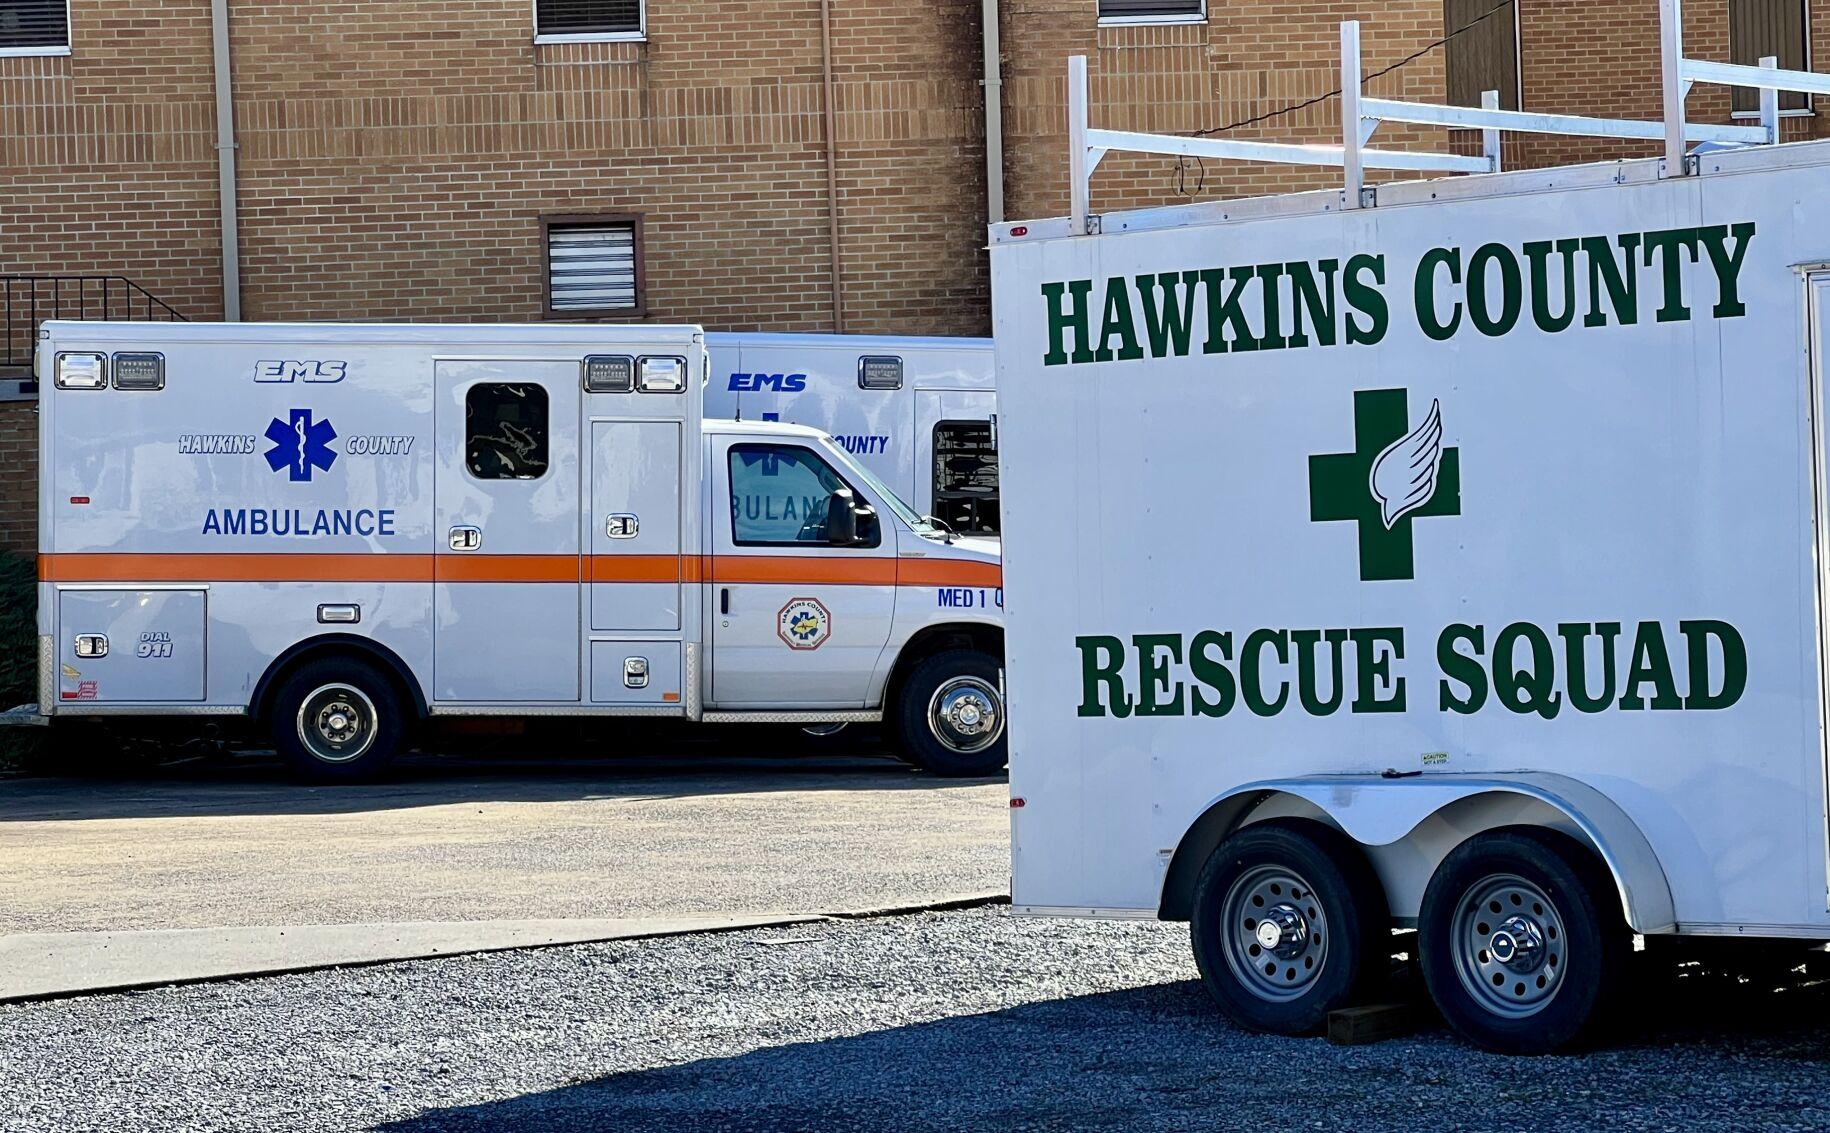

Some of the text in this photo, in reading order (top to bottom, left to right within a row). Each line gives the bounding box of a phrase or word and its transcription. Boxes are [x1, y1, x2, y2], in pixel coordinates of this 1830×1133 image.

[1041, 221, 1756, 366] HAWKINS COUNTY
[254, 360, 347, 383] EMS
[728, 373, 807, 392] EMS
[179, 435, 415, 455] HAWKINS COUNTY
[831, 435, 889, 454] OUNTY
[202, 509, 395, 536] AMBULANCE
[938, 588, 973, 607] MED
[140, 632, 171, 642] DIAL
[137, 643, 173, 658] 911
[1075, 619, 1748, 720] RESCUE SQUAD
